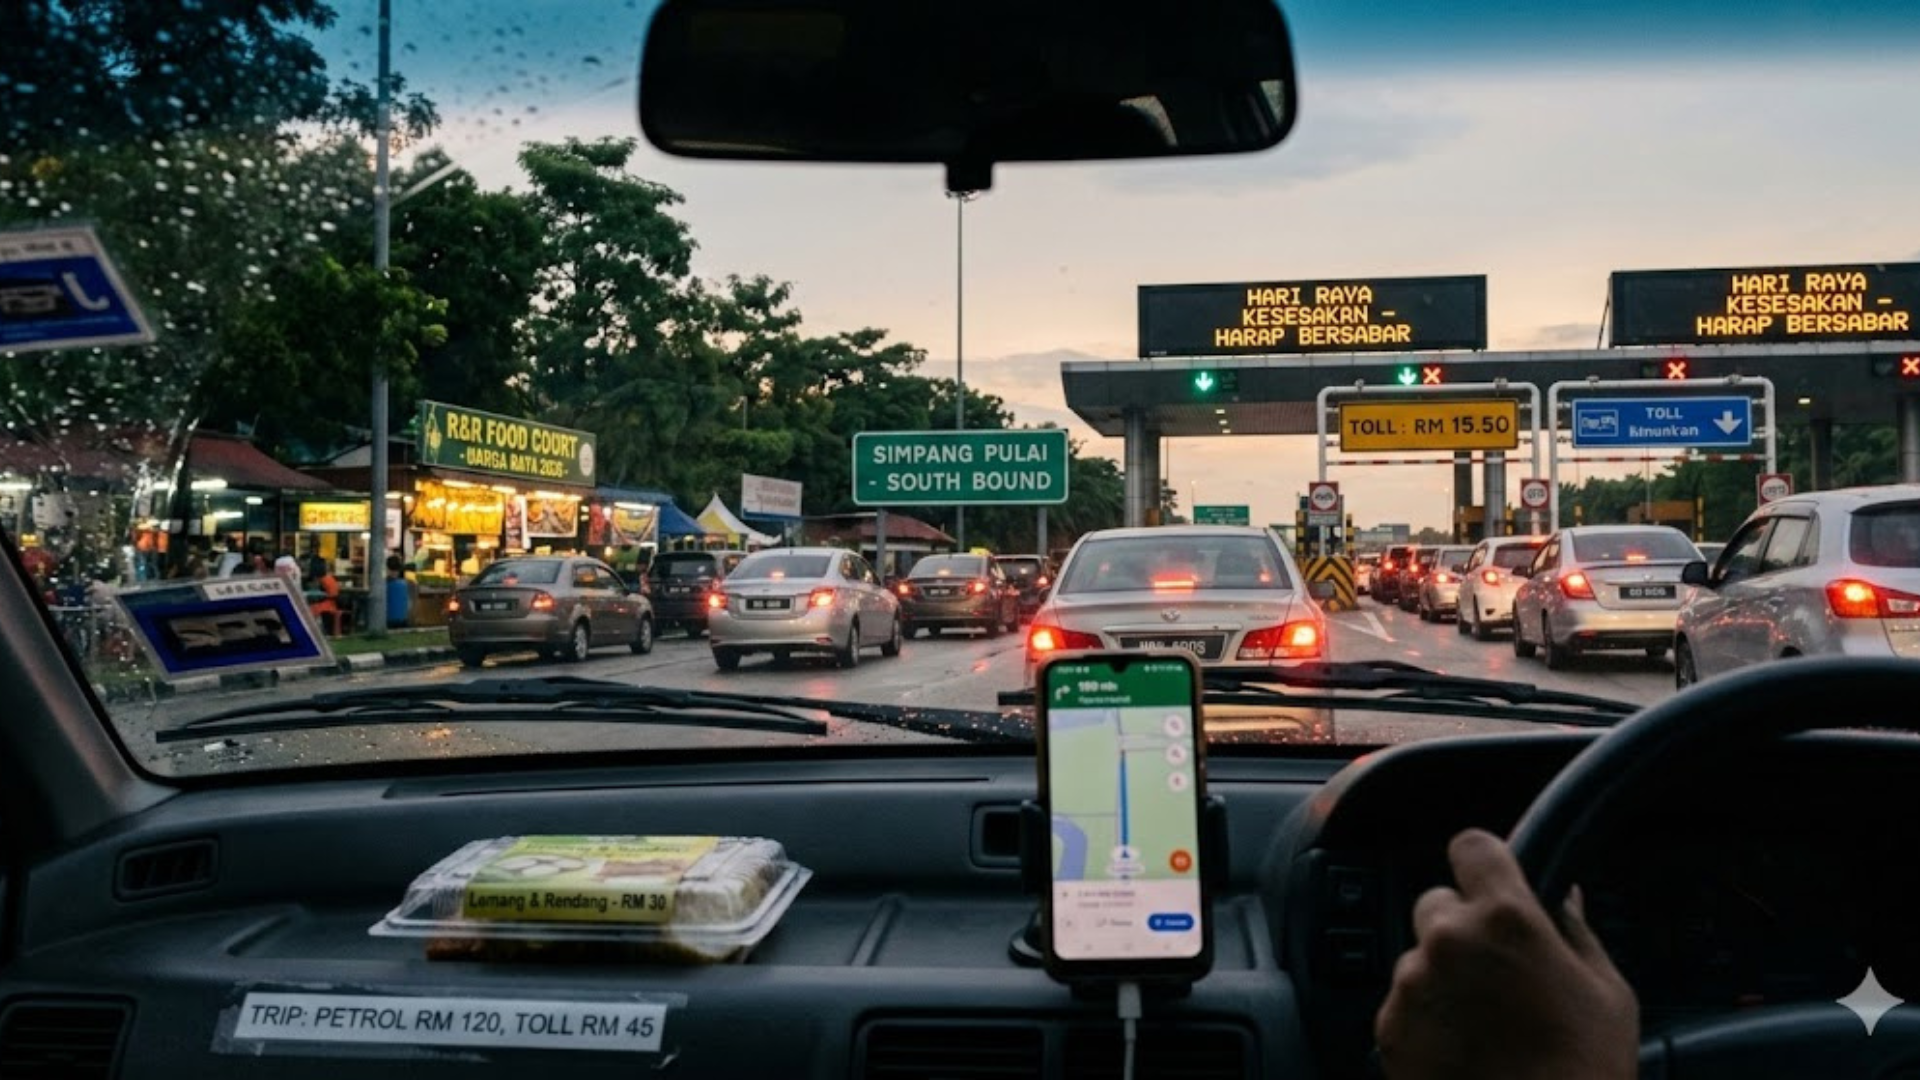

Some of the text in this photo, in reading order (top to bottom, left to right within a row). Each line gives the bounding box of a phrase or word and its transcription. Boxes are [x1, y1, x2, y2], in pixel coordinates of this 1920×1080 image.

[1732, 272, 1866, 294] HARI RAYA
[1247, 286, 1372, 306] HARI RAYA
[1726, 293, 1863, 314] KESESAKAN
[1697, 311, 1909, 336] HARAP BERSABAR
[1215, 324, 1411, 347] HARAP BERSABAR
[1645, 407, 1683, 419] TOLL
[1415, 419, 1443, 434] RM
[1452, 415, 1509, 434] 15.50
[447, 412, 578, 459] R&R FOOD COURT
[873, 444, 1047, 464] SIMPANG PULAI
[887, 472, 960, 491] SOUTH
[972, 471, 1051, 490] BOUND
[531, 893, 540, 908] &
[545, 892, 607, 912] Rendang
[621, 894, 645, 909] RM
[649, 894, 667, 910] 30
[251, 1004, 654, 1037] TRIP: PETROL RM 120, TOLL RM 45
